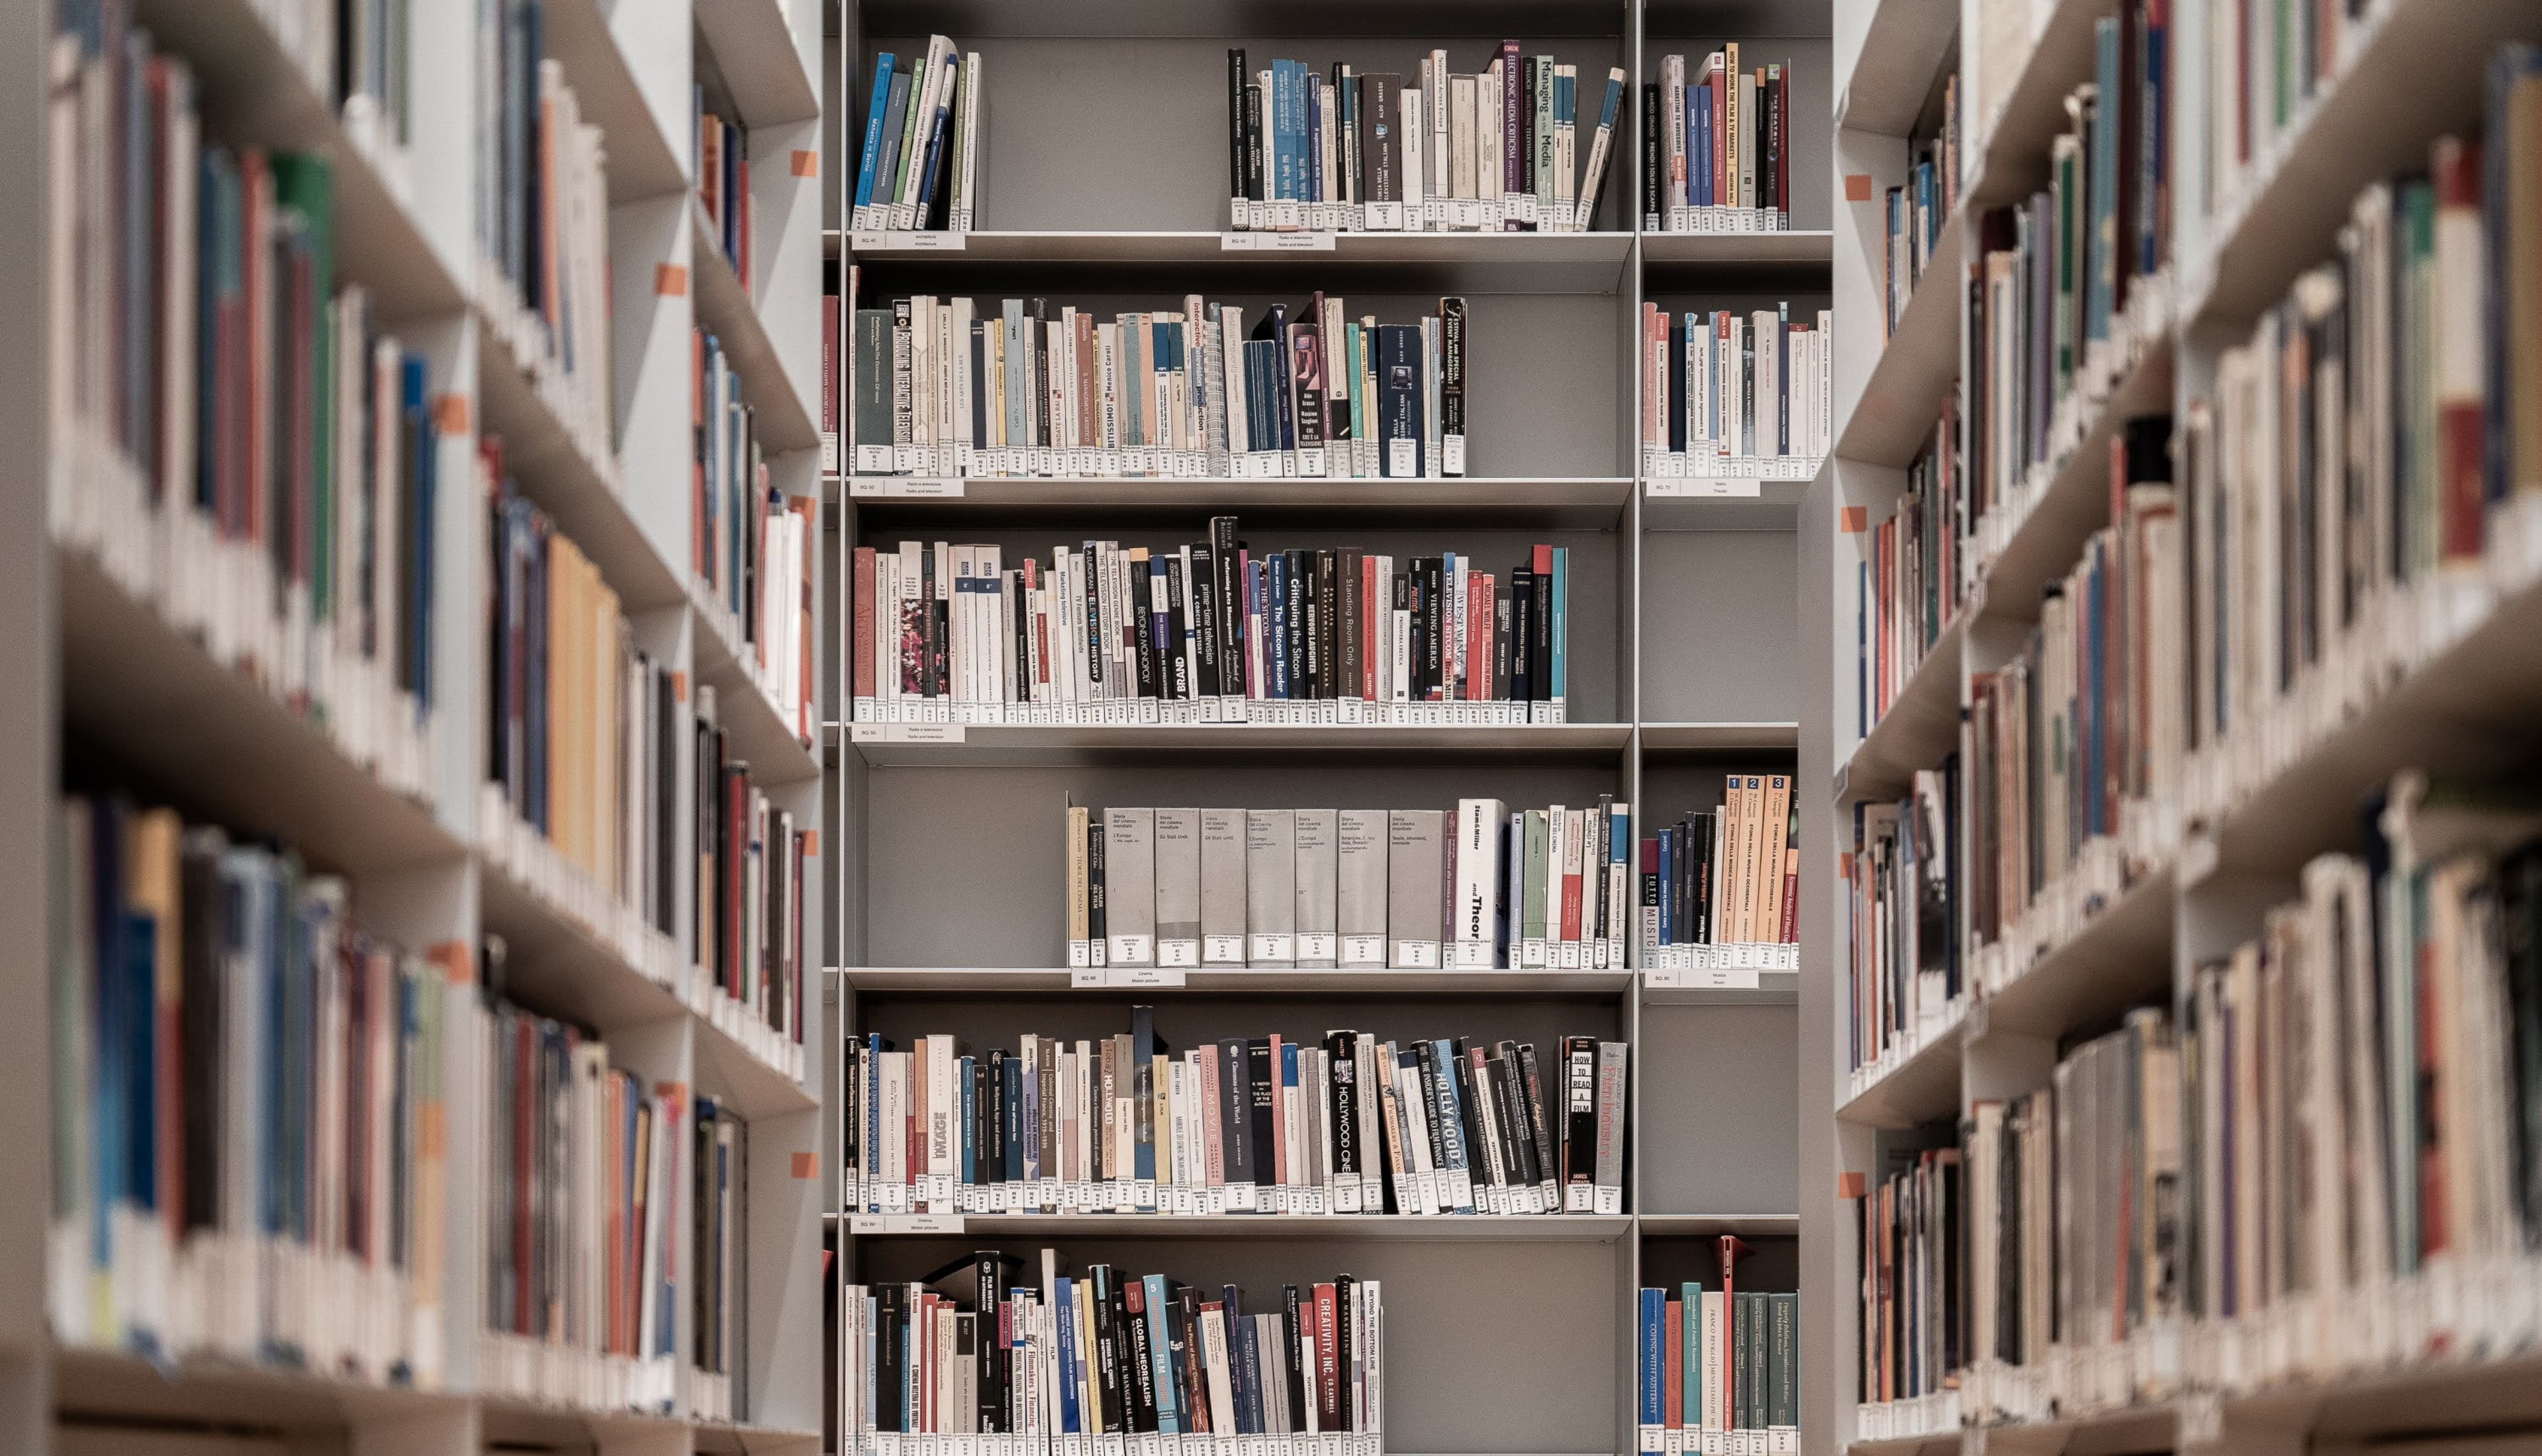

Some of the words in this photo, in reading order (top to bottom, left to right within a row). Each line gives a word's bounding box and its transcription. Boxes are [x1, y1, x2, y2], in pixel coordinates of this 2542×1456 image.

[1540, 61, 1551, 113] Managing
[1542, 135, 1552, 167] Media
[1445, 303, 1462, 342] FESTIVAL
[896, 332, 912, 369] PRODUCING
[896, 371, 911, 409] INTERACTIVE
[1196, 387, 1204, 431] production
[1088, 591, 1098, 645] TELEVISION
[1138, 606, 1147, 637] BEYOND
[1290, 578, 1299, 627] Critiquing
[1200, 584, 1210, 627] prime-time
[1205, 628, 1213, 664] television
[1141, 639, 1150, 683] MONOPOLY
[1175, 657, 1186, 692] BRAND
[1292, 647, 1301, 678] Sitcom
[1424, 1074, 1433, 1100] INSIDER'S
[1573, 1080, 1590, 1089] READ
[1207, 1094, 1217, 1140] MOVIE
[1339, 1087, 1349, 1148] HOLLYWOOD
[1425, 1101, 1436, 1118] GUIDE
[1436, 1073, 1461, 1159] HOLLYWOOD
[1433, 1144, 1444, 1166] FINANCE
[1136, 1318, 1145, 1352] GLOBAL
[1321, 1298, 1332, 1355] CREATIVITY,
[1139, 1353, 1151, 1406] NEOREALISM
[1156, 1354, 1165, 1373] FILM
[1323, 1357, 1333, 1375] INC.
